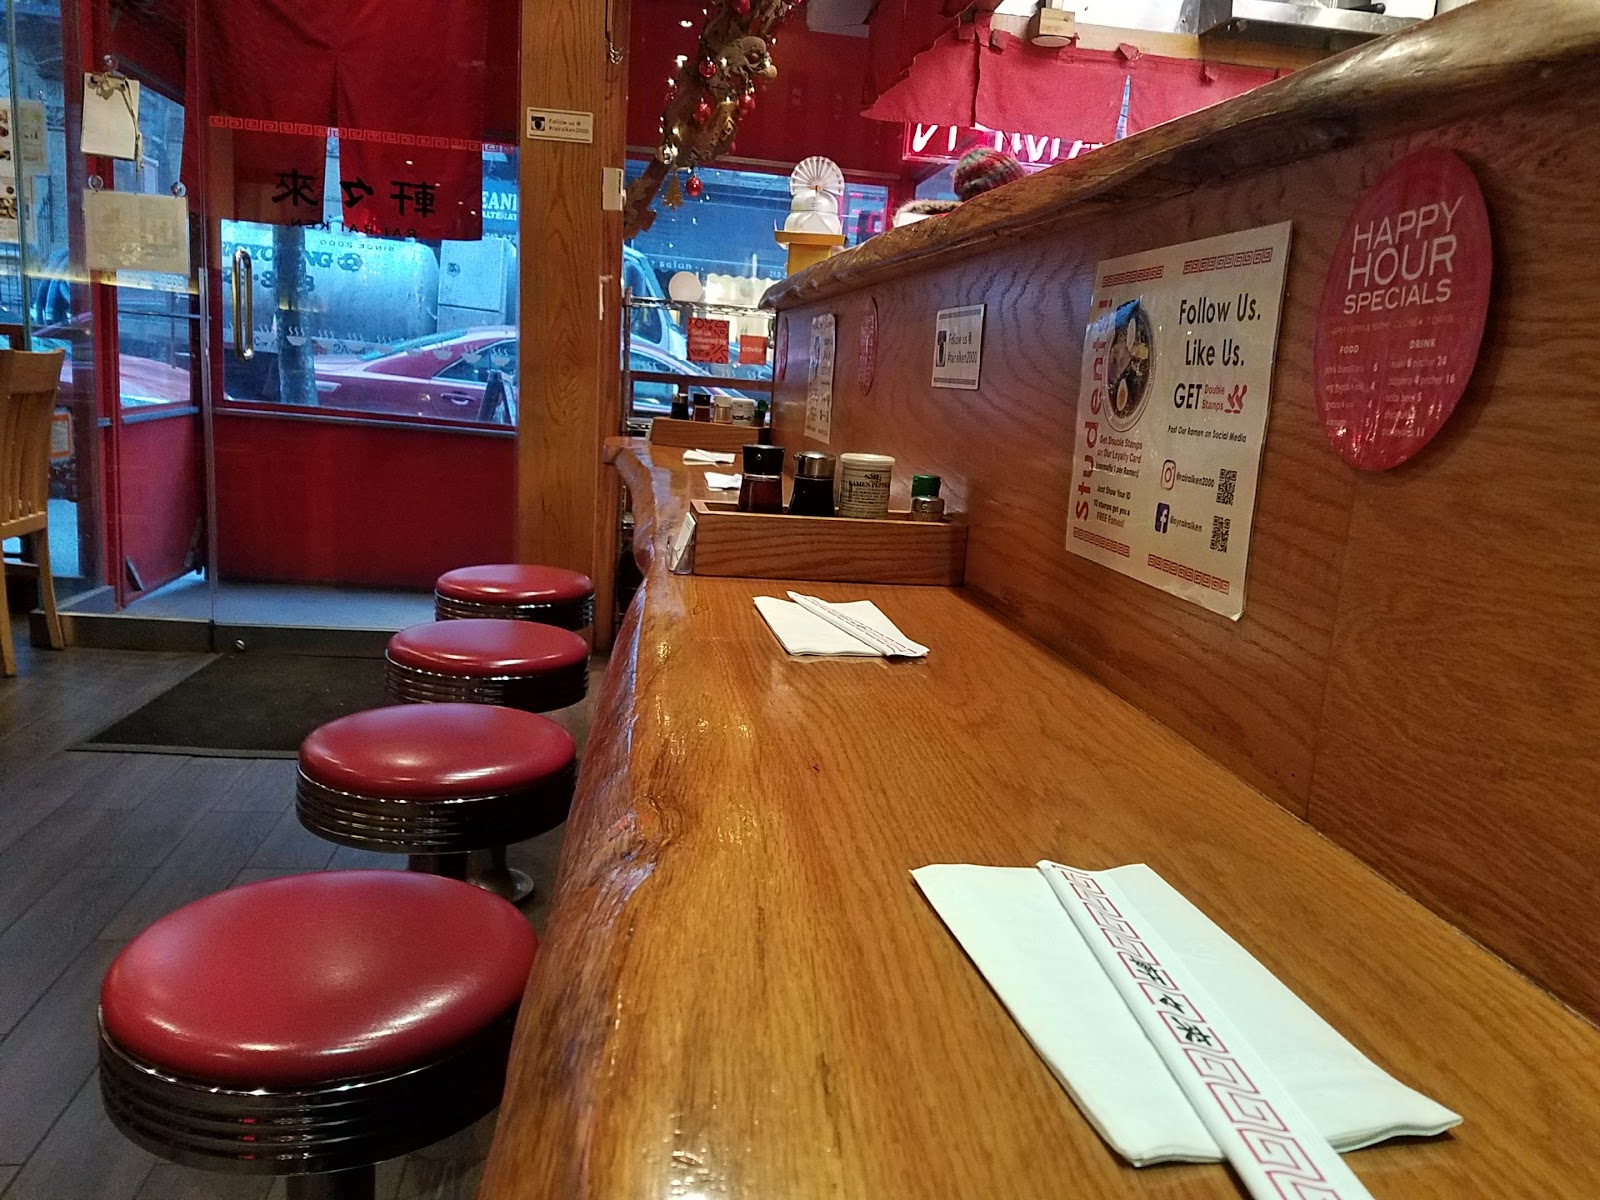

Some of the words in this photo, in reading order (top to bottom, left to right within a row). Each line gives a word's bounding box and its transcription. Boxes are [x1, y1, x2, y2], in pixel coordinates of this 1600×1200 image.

[1353, 195, 1464, 254] HAPPY
[1347, 234, 1457, 290] HOUR
[1343, 278, 1452, 315] SPECIALS
[1179, 296, 1232, 326] Follow
[1236, 292, 1261, 322] Us.
[1339, 344, 1359, 354] FOOD
[1409, 338, 1436, 350] DRINK
[1185, 338, 1215, 367] Like
[1222, 338, 1245, 367] Us.
[1173, 382, 1203, 410] GET
[1204, 383, 1226, 396] Double
[1201, 399, 1225, 413] Stamps
[1167, 425, 1178, 434] Post
[1178, 426, 1187, 435] Our
[1187, 427, 1204, 438] Ramen
[1205, 430, 1212, 438] on
[1212, 429, 1229, 441] Social
[1229, 431, 1247, 443] Media
[1100, 435, 1108, 444] Get
[1108, 436, 1124, 447] Double
[1124, 438, 1143, 450] Stamps
[1104, 448, 1112, 458] Our
[1112, 449, 1129, 463] Loyalty
[1129, 452, 1142, 464] Card
[1097, 484, 1106, 494] Just
[1105, 486, 1117, 496] Show
[1117, 489, 1126, 498] Your
[1098, 501, 1112, 511] stamps
[1096, 511, 1108, 523] FREE
